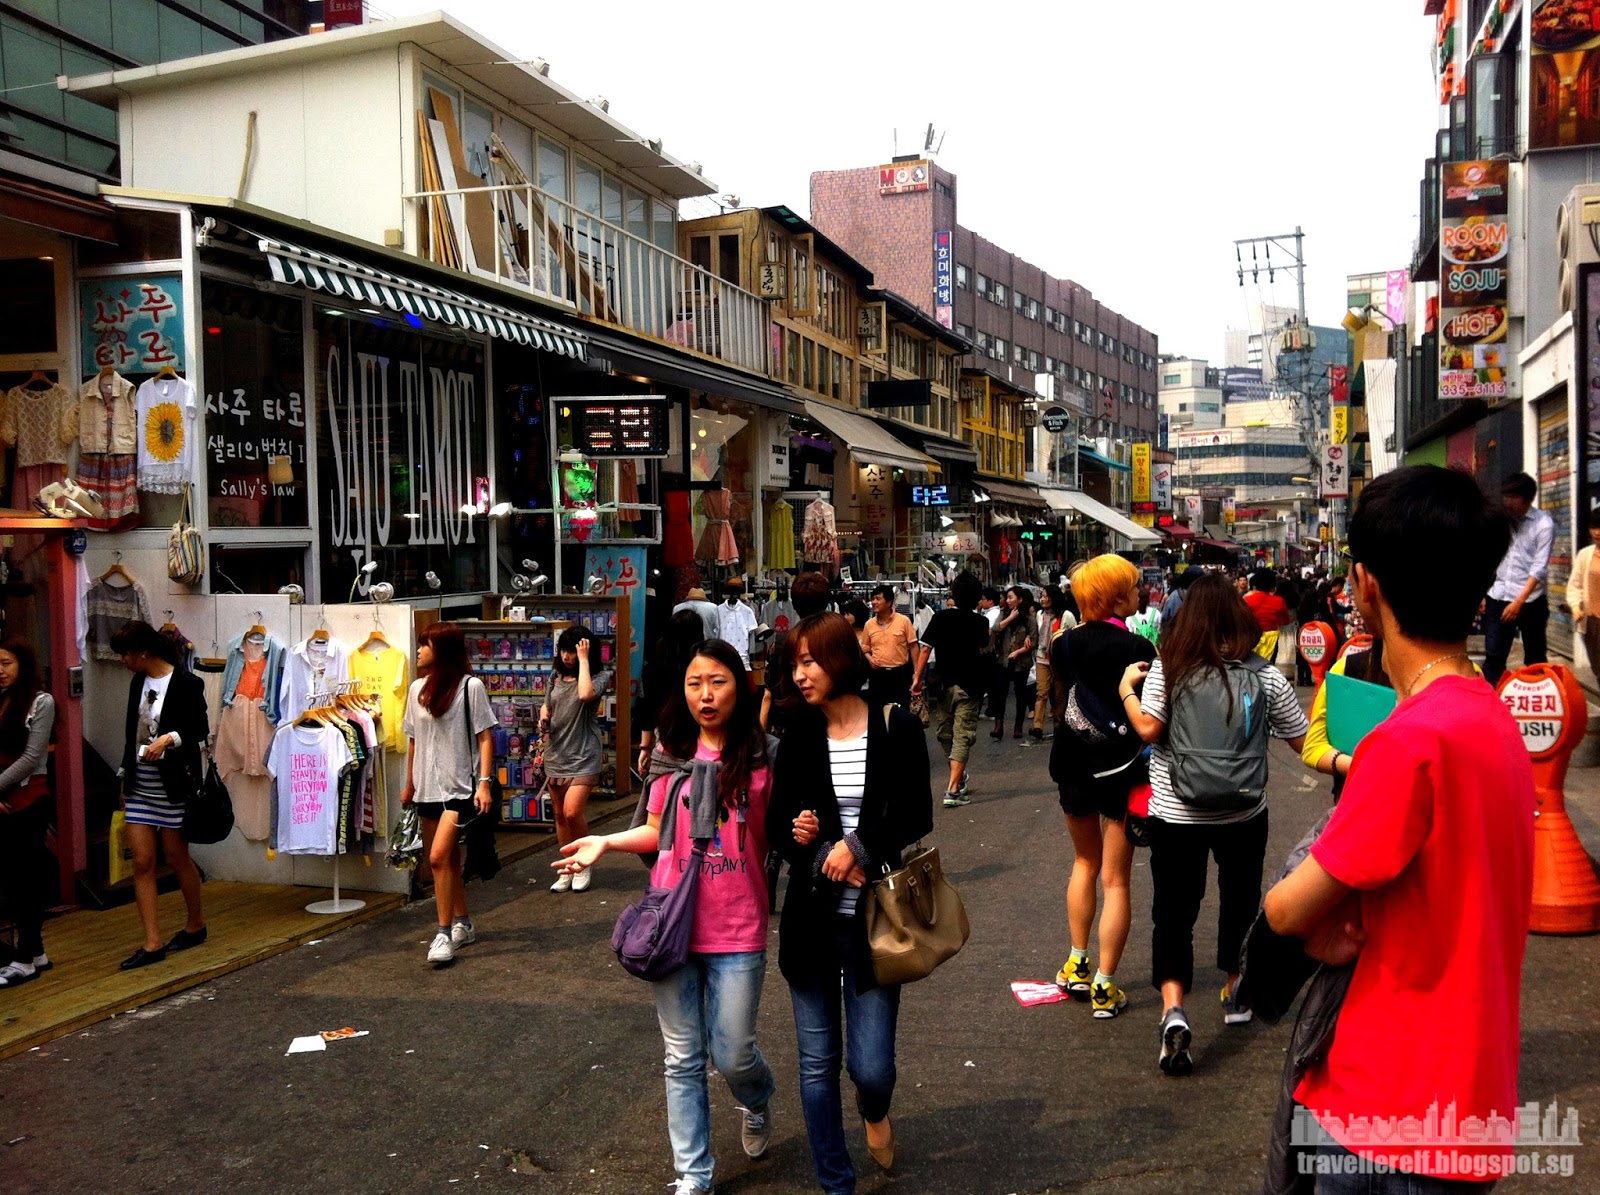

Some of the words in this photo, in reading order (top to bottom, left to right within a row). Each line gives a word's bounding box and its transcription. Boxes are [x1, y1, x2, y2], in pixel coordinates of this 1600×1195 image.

[1443, 224, 1507, 246] ROOM
[938, 246, 950, 303] 호미화방
[1449, 268, 1500, 292] SOJU
[1452, 313, 1495, 337] HOF
[1443, 382, 1505, 397] 335-3113
[205, 388, 251, 427] 사주
[263, 391, 305, 428] 타로
[399, 338, 476, 557] TAROT
[221, 478, 267, 499] Sally's
[273, 481, 296, 497] law
[912, 485, 950, 506] 타로
[1301, 635, 1322, 644] 주차금지
[1504, 695, 1557, 713] 주차금지
[1516, 722, 1555, 737] USH
[290, 754, 317, 769] THERE
[290, 769, 317, 781] BEAUTY
